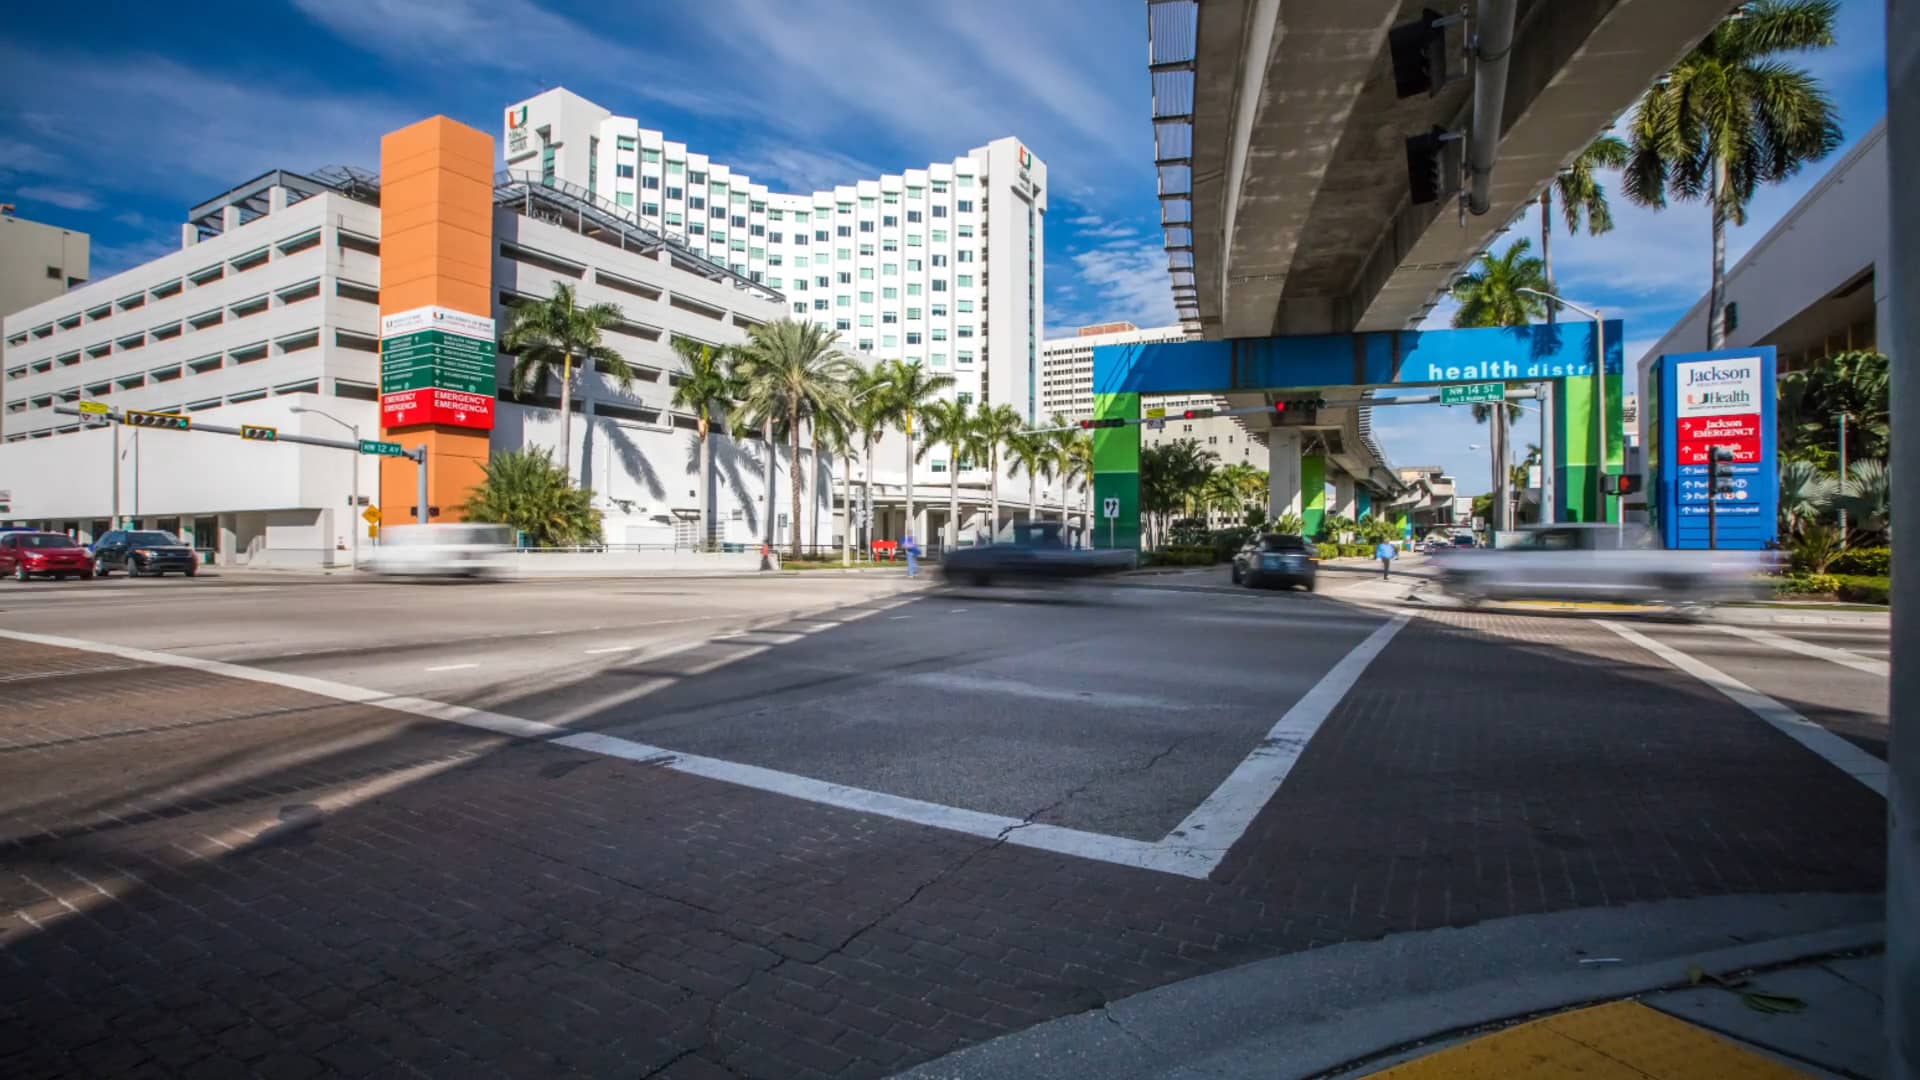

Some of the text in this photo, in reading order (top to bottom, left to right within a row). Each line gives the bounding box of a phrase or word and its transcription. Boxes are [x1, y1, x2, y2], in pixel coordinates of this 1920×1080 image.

[1428, 360, 1620, 380] health distrit
[1687, 366, 1751, 386] Jackson
[1449, 384, 1495, 396] NW 14 ST
[434, 390, 487, 405] EMERGENCY
[434, 399, 488, 414] EMERGENCIA
[1704, 419, 1742, 430] Jackson
[1693, 427, 1754, 438] EMERGENCY
[378, 444, 388, 453] 12
